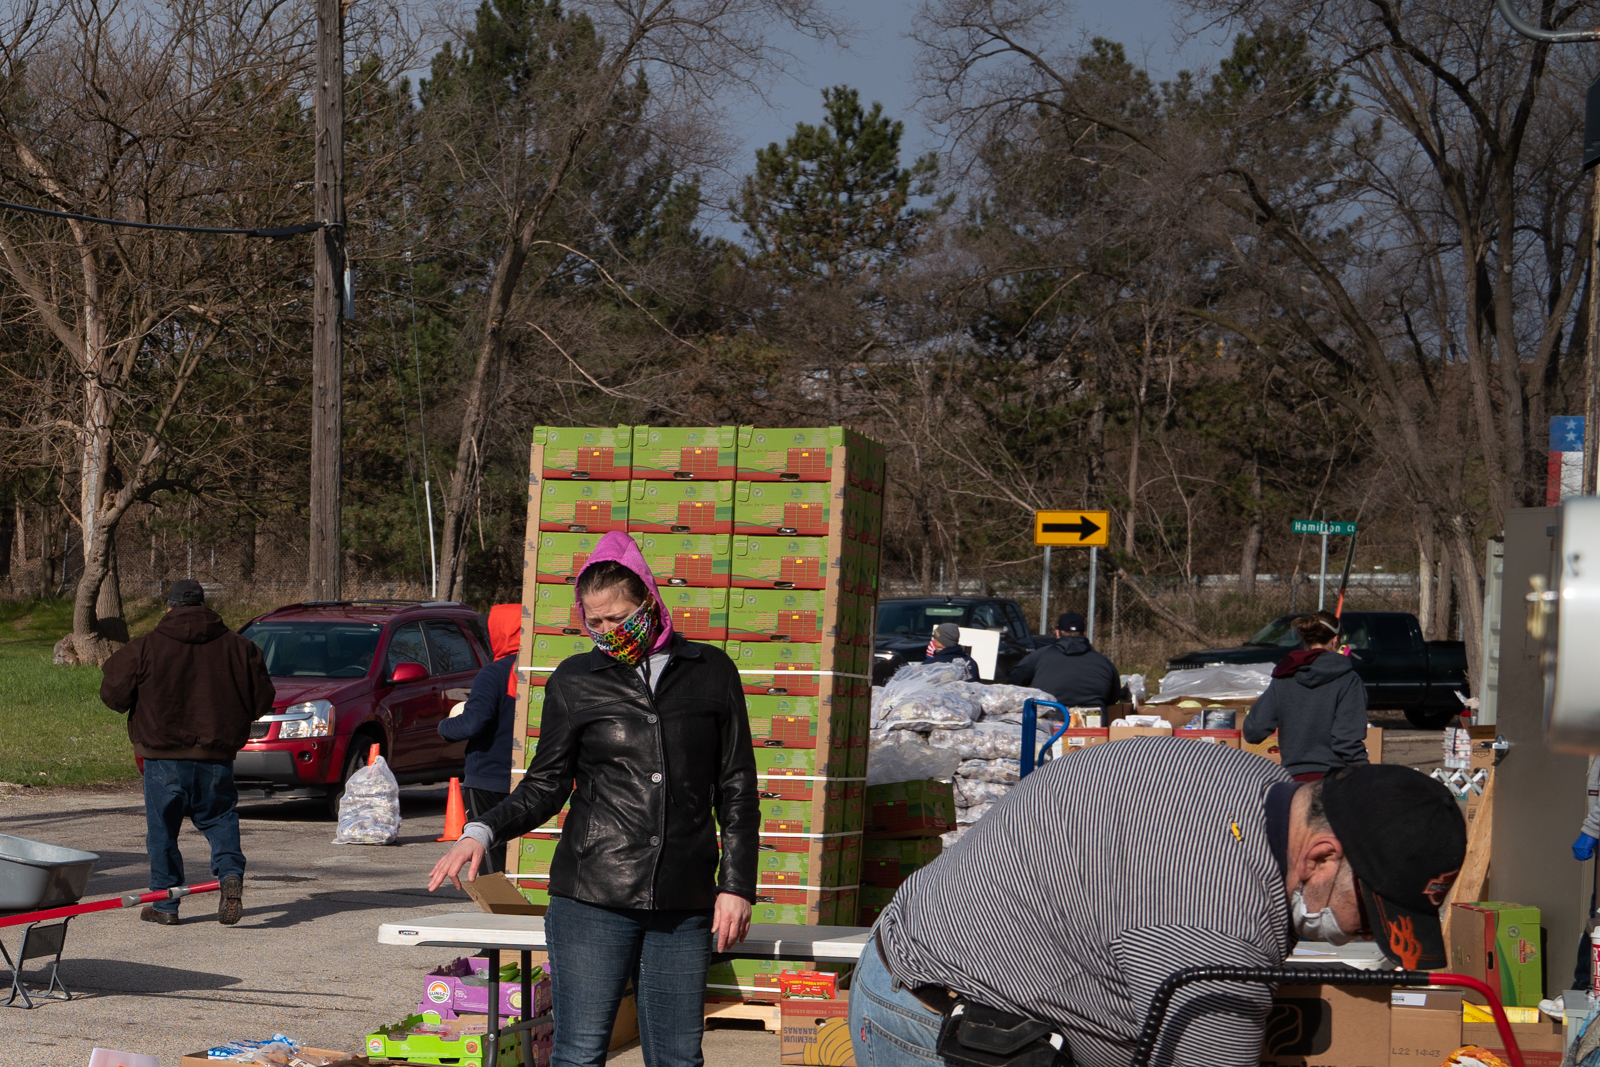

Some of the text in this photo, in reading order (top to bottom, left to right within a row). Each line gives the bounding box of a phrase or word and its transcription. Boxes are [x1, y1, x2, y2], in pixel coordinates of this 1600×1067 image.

[1295, 522, 1354, 532] Hamilton Ct
[1416, 1049, 1440, 1058] 14:43
